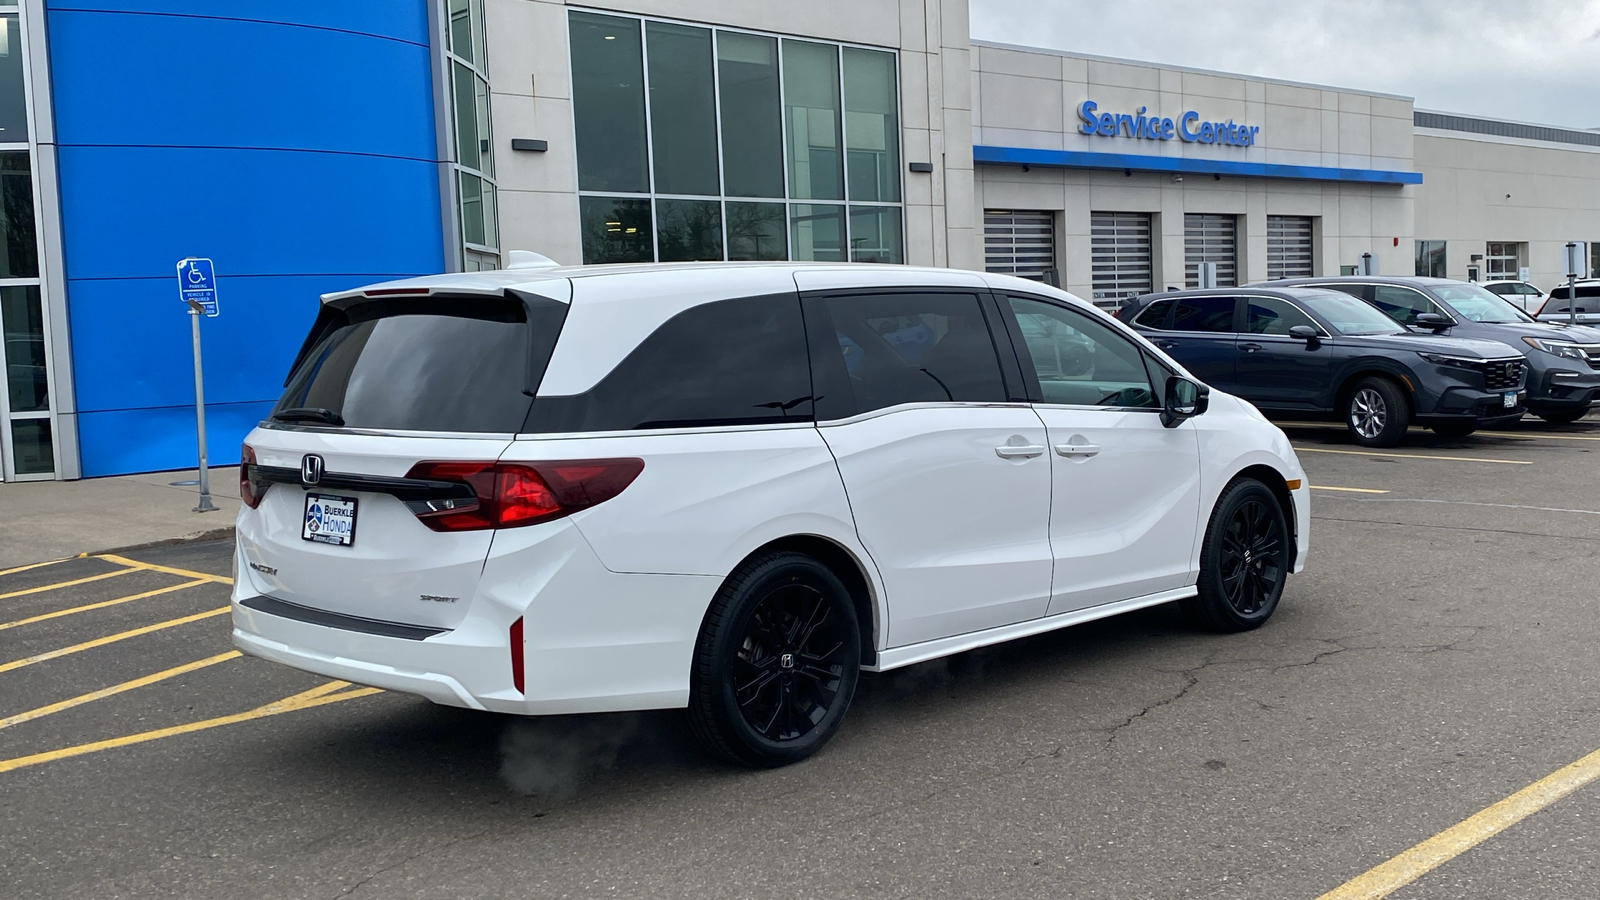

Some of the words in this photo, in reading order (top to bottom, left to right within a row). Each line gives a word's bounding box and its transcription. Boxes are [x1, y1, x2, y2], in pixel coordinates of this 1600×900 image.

[1079, 100, 1174, 141] Service
[1178, 110, 1260, 147] Center
[324, 504, 353, 517] BUERKLE
[323, 515, 351, 533] HONDA
